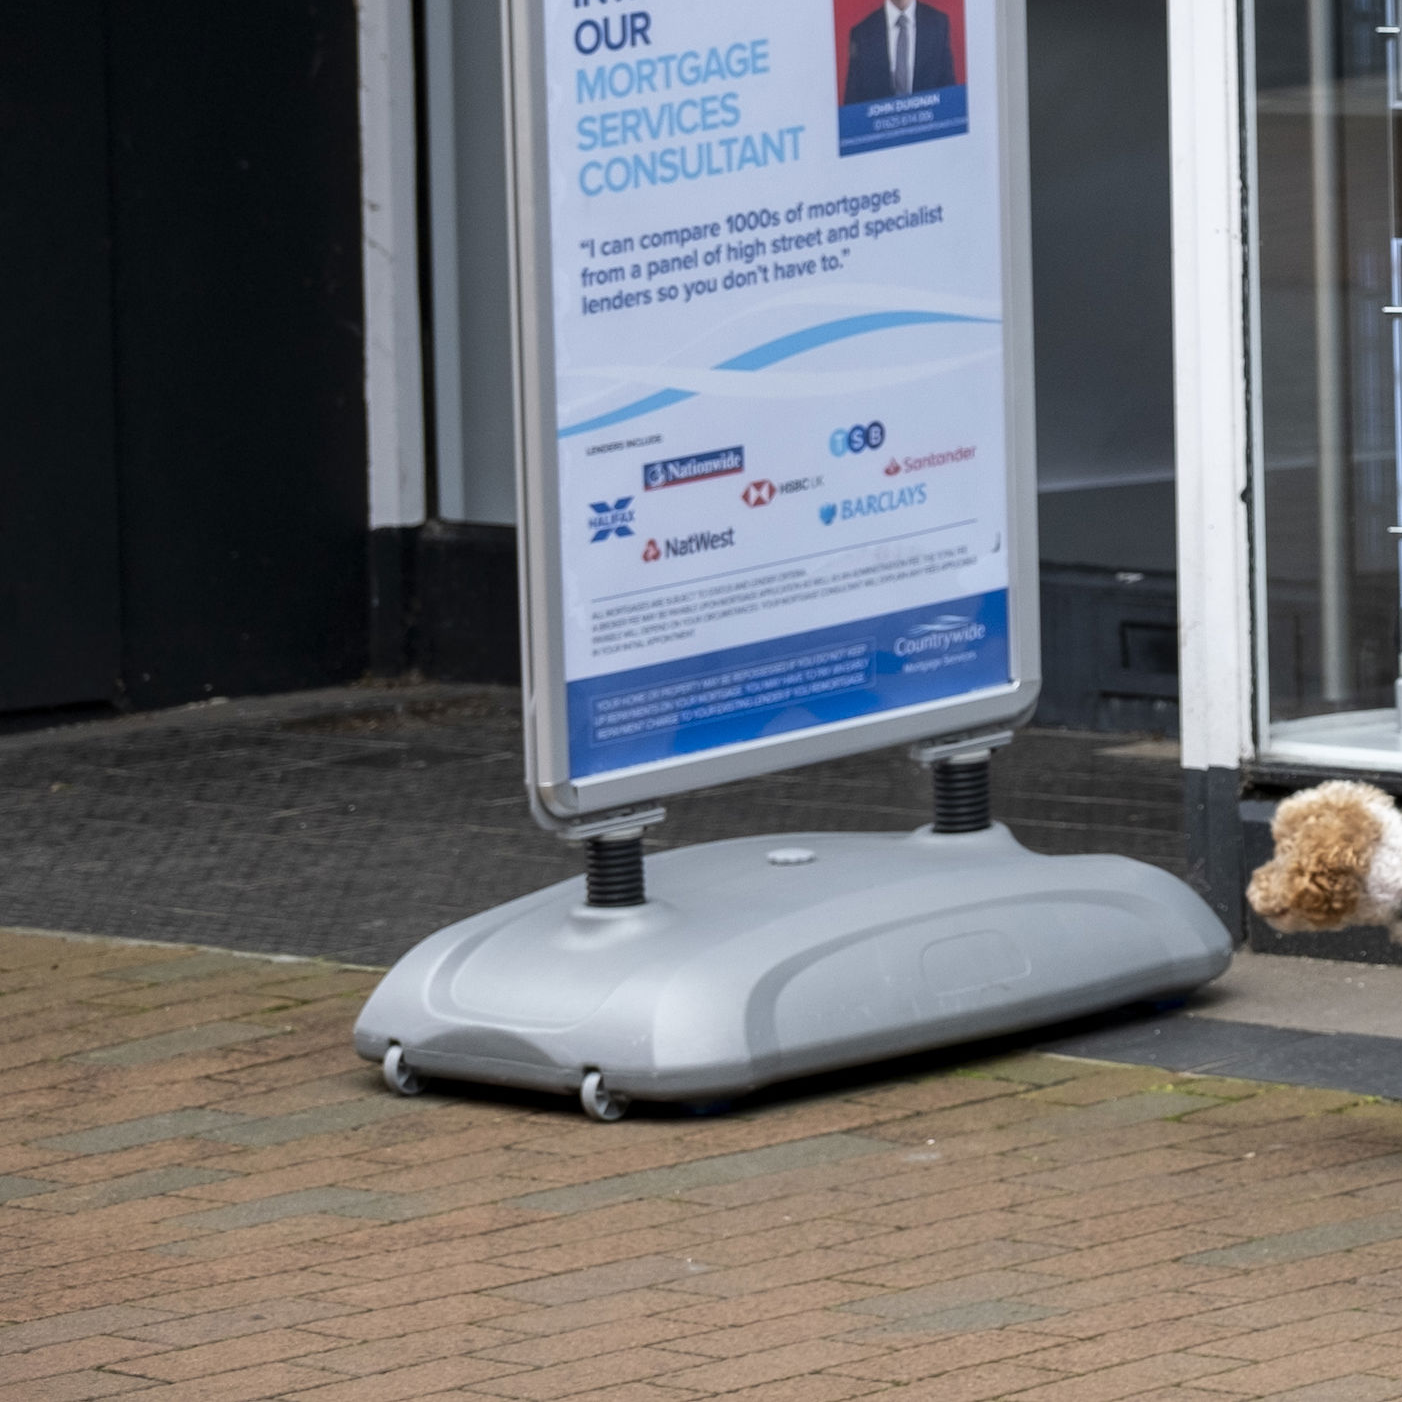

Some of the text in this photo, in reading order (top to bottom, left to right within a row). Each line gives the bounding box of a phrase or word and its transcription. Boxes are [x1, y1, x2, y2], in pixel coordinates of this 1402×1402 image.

[575, 11, 652, 55] OUR
[577, 38, 769, 104] MORTGAGE
[577, 92, 741, 153] SERVICES
[579, 125, 806, 198] CONSULTANT
[600, 238, 635, 257] can
[640, 224, 721, 253] compare
[725, 210, 781, 235] 1000s
[785, 199, 805, 224] of
[807, 188, 901, 220] mortgages
[581, 204, 944, 288] from a panel of high street and specialist
[581, 288, 653, 316] lenders
[657, 283, 679, 302] so
[684, 277, 718, 304] you
[723, 266, 771, 292] don't
[774, 254, 818, 282] have
[832, 424, 884, 455] TSB
[668, 450, 742, 482] Nationwide
[904, 445, 976, 474] Santander
[779, 478, 810, 495] HSBC
[841, 483, 927, 520] BARCLAYS
[588, 510, 636, 530] HALIFAX
[665, 528, 735, 558] NatWest
[894, 621, 986, 657] Countrywide
